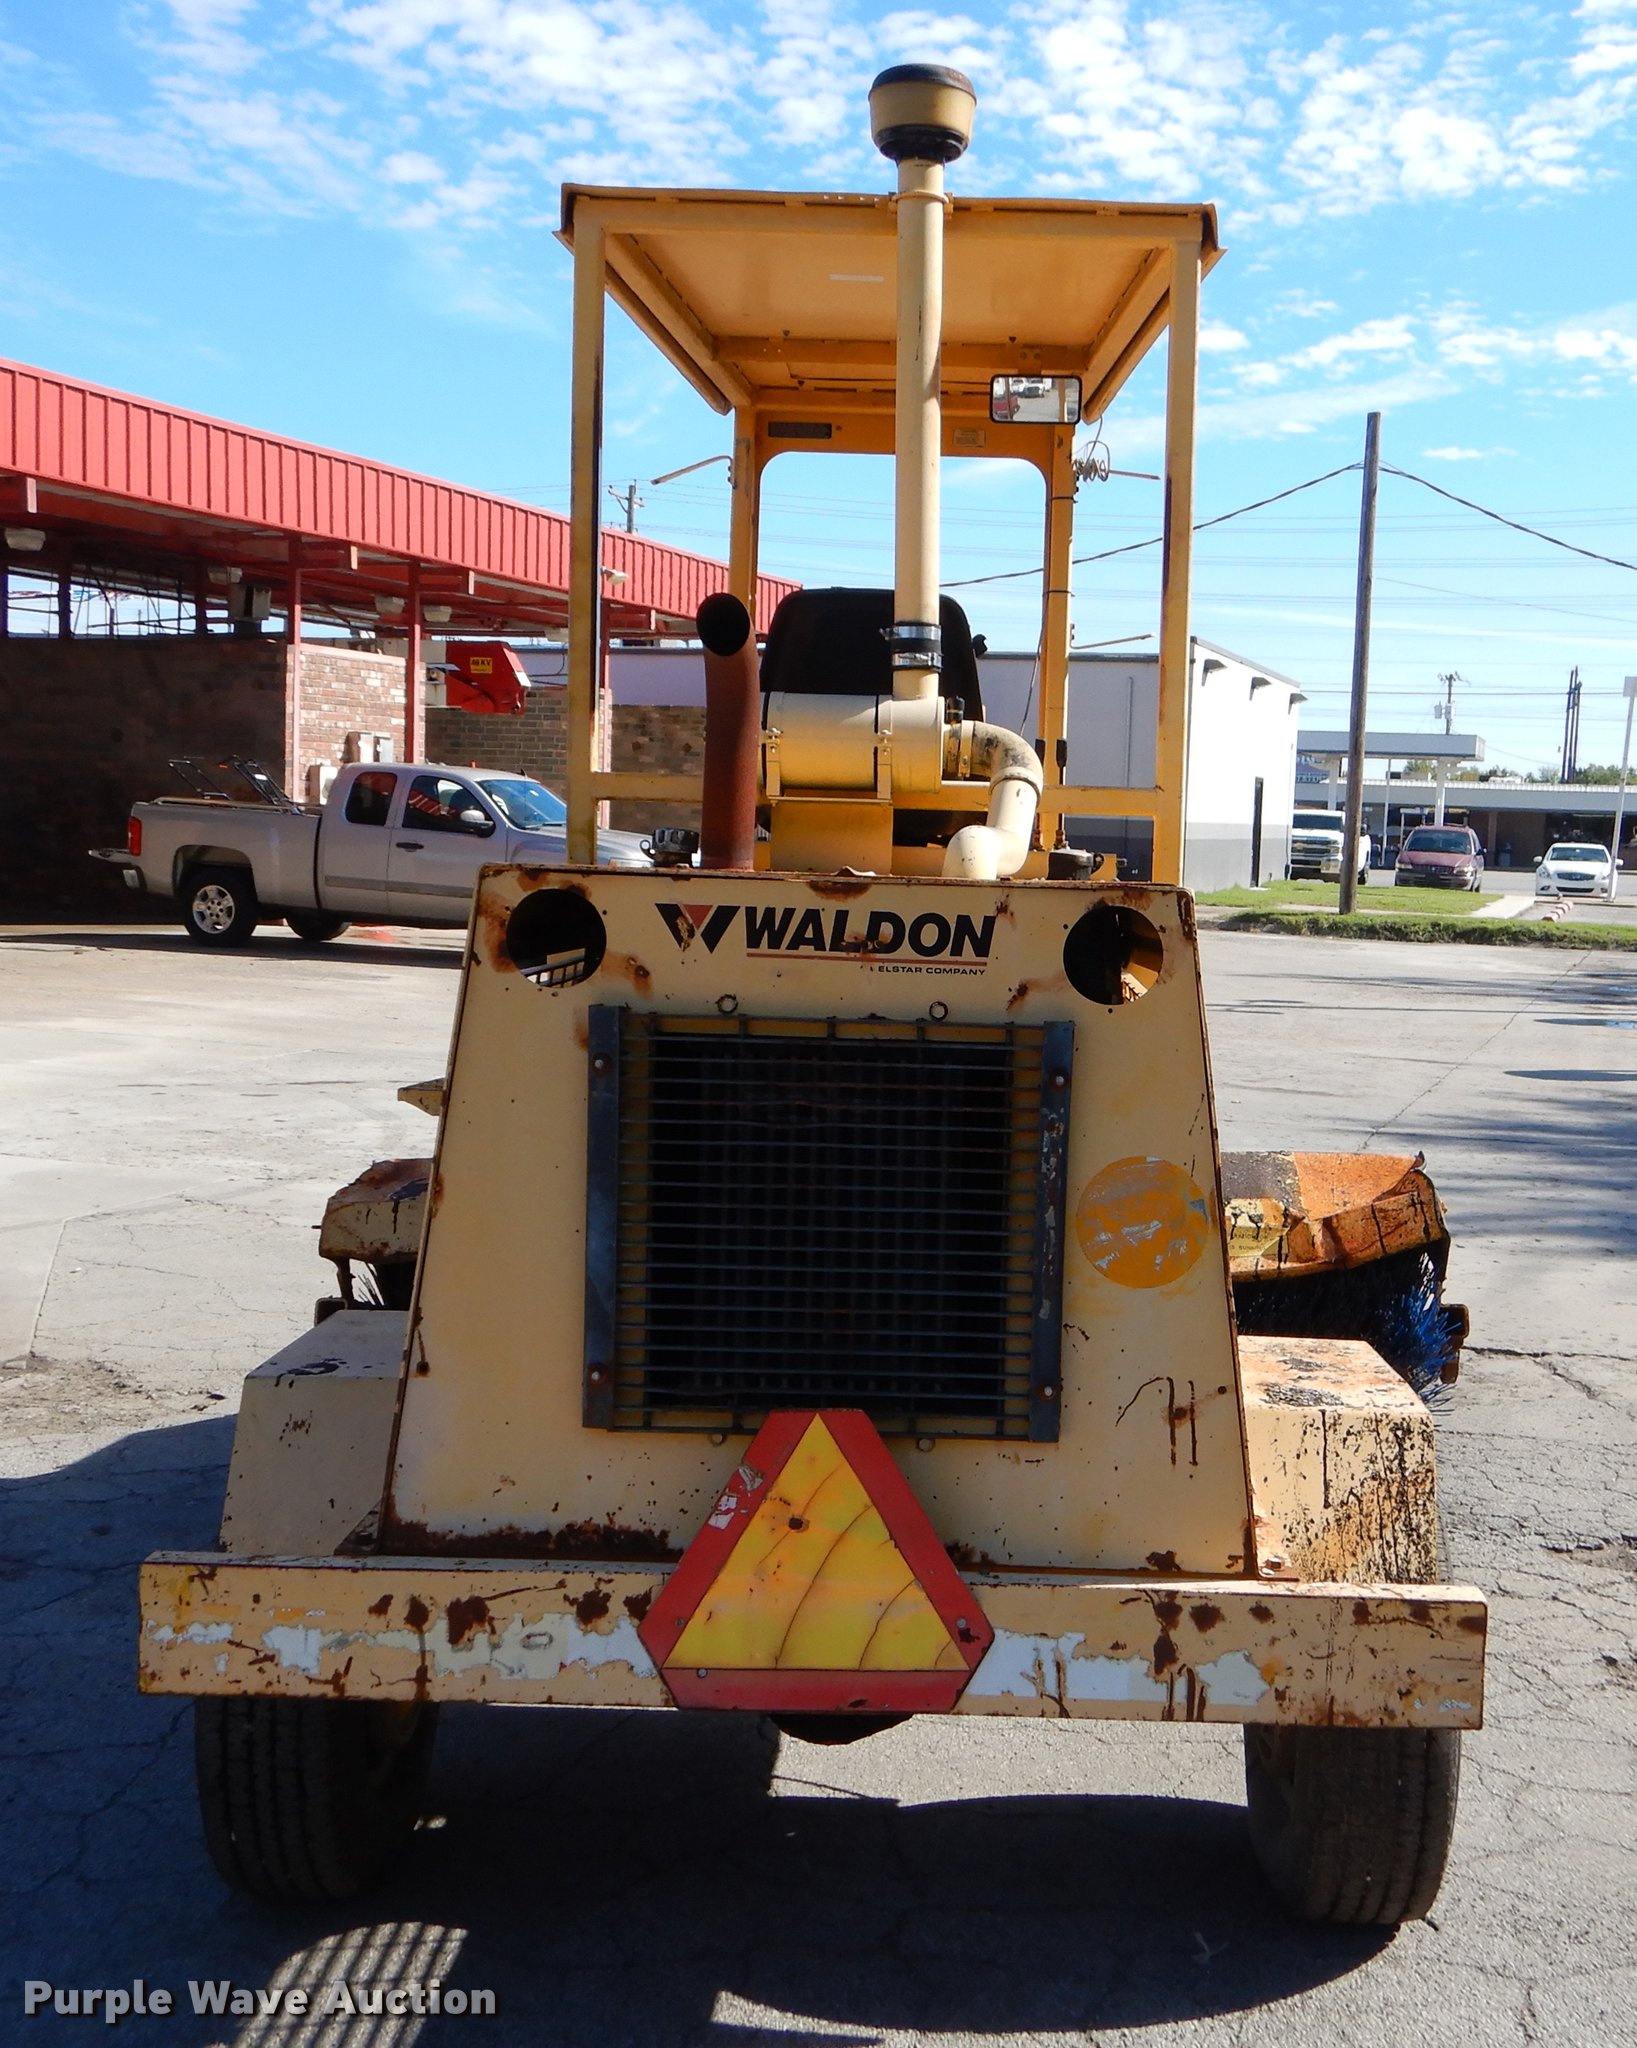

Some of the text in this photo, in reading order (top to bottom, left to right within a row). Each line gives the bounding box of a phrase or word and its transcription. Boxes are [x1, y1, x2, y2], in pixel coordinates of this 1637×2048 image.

[745, 905, 996, 957] WALDON
[878, 965, 923, 974] ELSTAR
[925, 967, 986, 976] COMPANY
